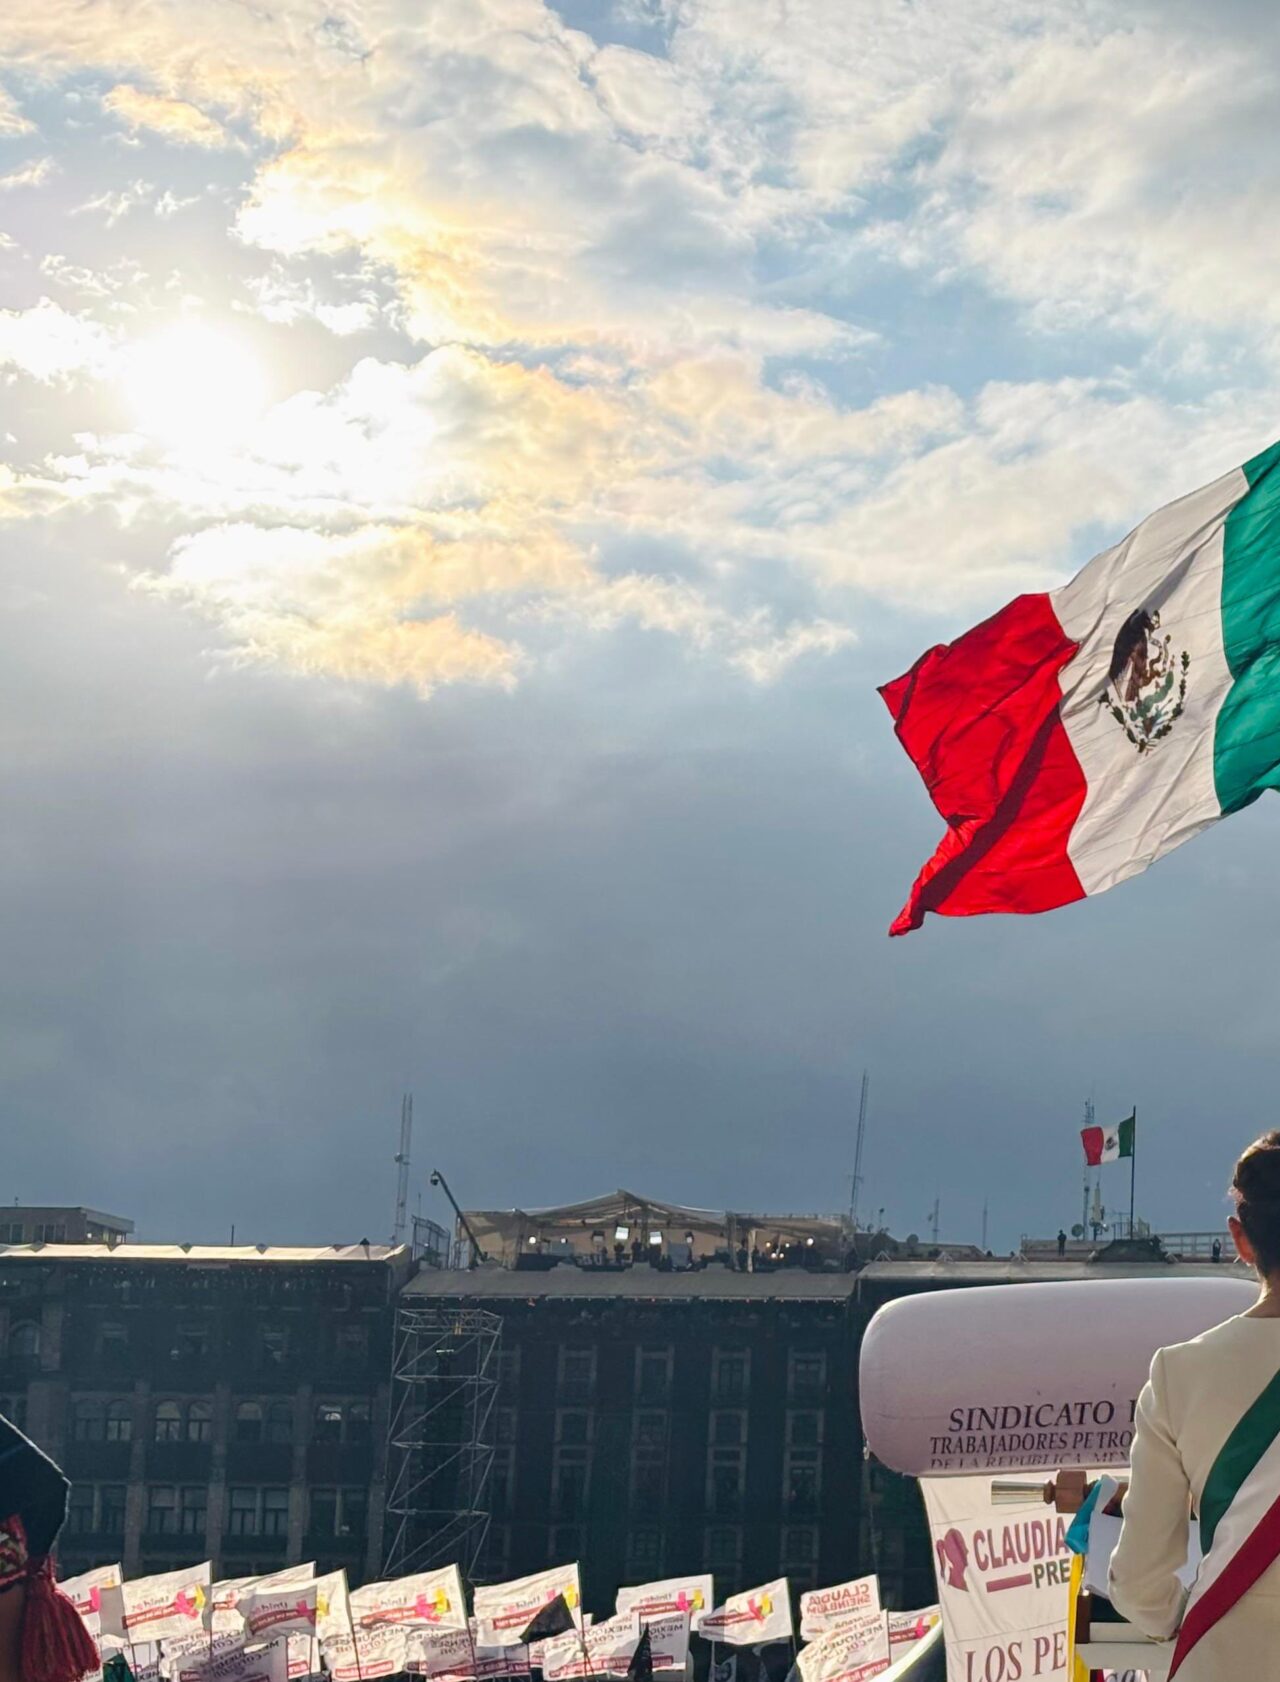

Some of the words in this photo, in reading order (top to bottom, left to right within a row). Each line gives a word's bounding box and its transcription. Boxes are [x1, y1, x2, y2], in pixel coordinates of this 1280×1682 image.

[949, 1400, 1115, 1432] SINDICATO
[930, 1432, 1068, 1456] TRABAJADORES
[973, 1516, 1069, 1571] CLAUDIA
[1033, 1557, 1070, 1589] PRE
[965, 1642, 1022, 1682] LOS
[1032, 1630, 1067, 1676] PE
